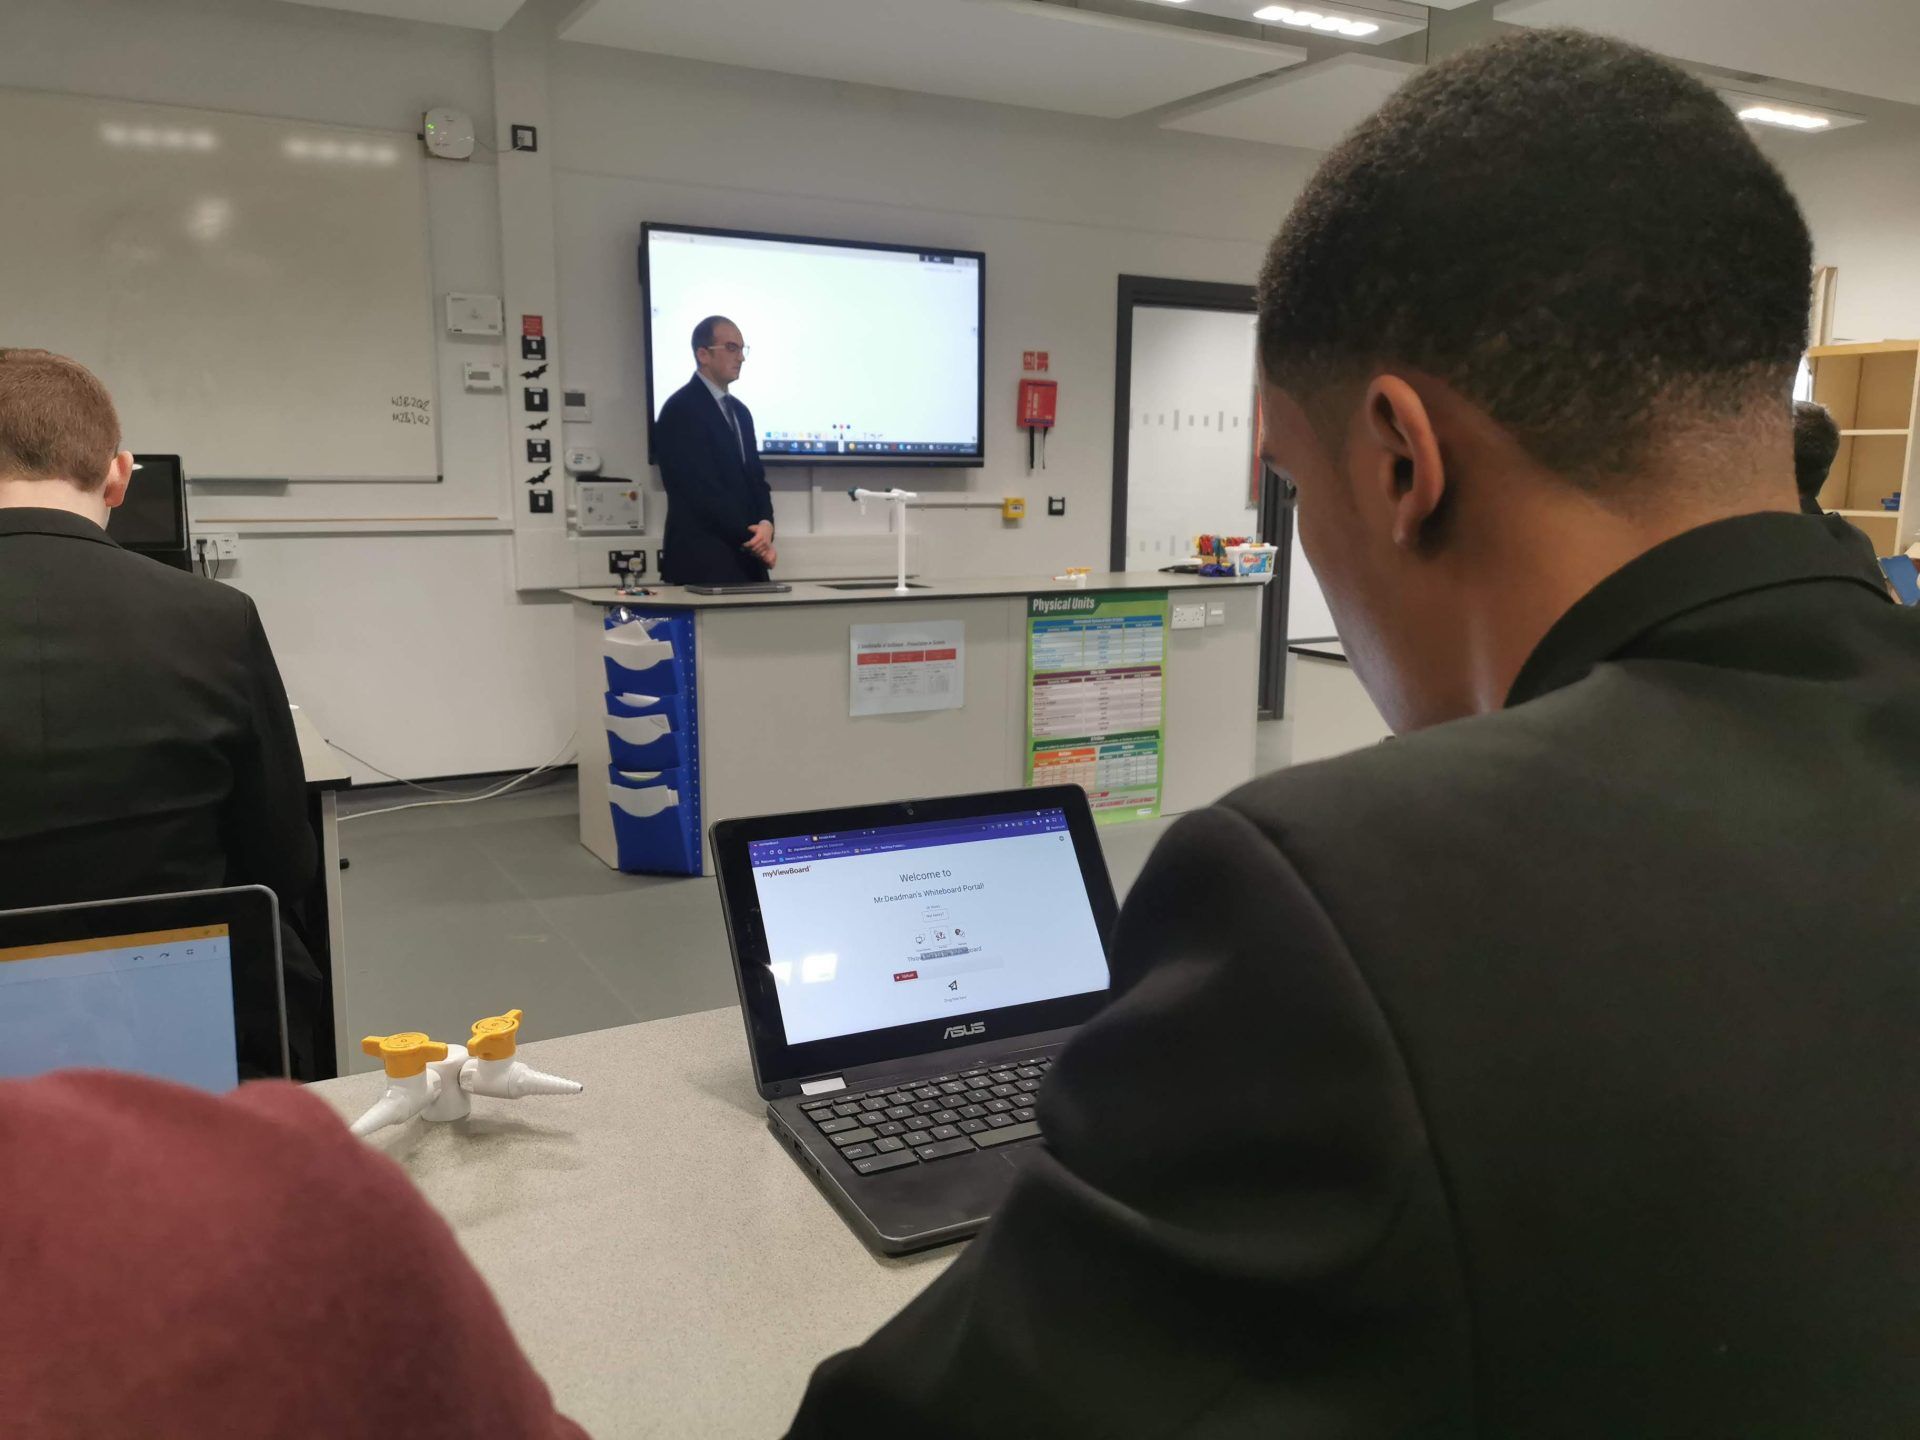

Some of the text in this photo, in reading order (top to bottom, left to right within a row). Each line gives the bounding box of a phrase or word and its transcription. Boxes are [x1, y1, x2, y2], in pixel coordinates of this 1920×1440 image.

[1032, 597, 1095, 613] Physical Units
[762, 865, 810, 878] myViewBoard
[899, 869, 952, 882] Welcome to
[923, 886, 962, 897] Whiteboard
[962, 882, 985, 892] Portal!
[943, 1021, 986, 1040] ASUS
